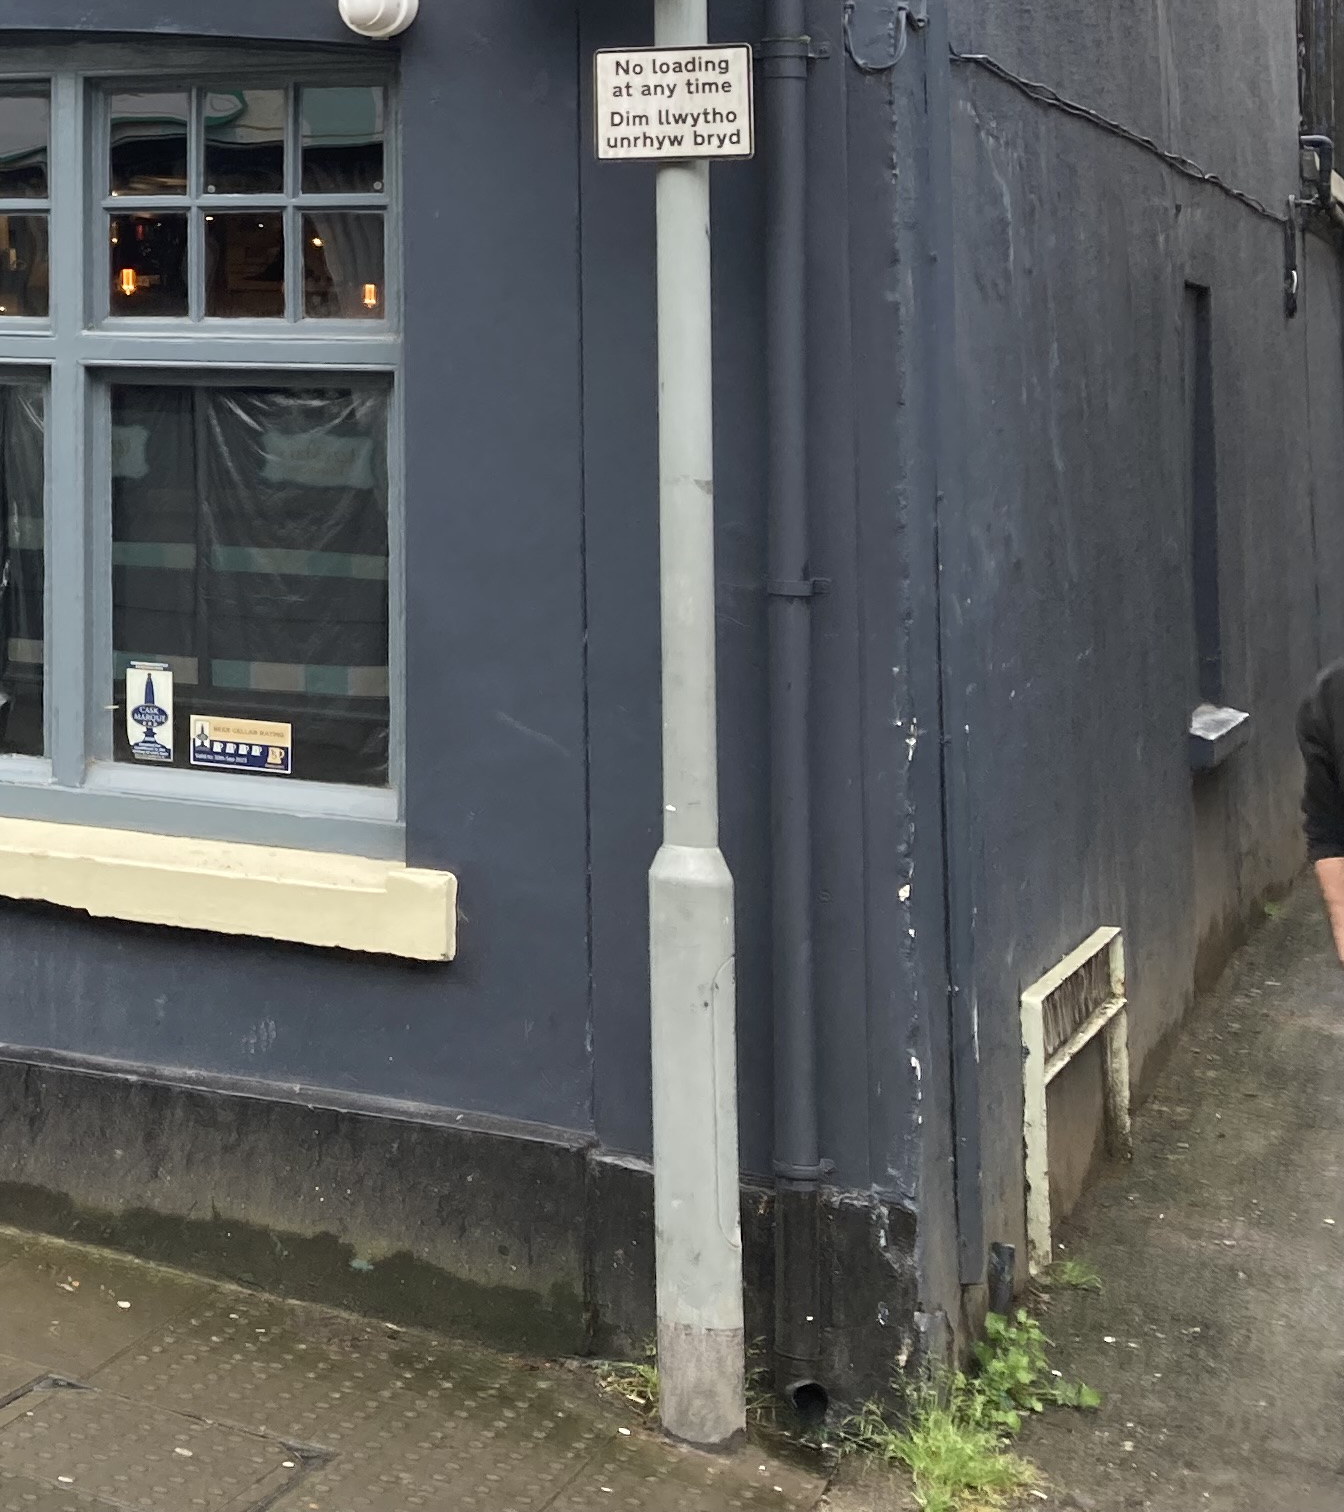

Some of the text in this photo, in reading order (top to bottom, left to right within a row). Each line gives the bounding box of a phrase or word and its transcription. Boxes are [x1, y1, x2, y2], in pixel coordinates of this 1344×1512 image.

[615, 56, 729, 75] No loading
[612, 78, 732, 98] at any time
[610, 108, 737, 127] Dim llwytho
[607, 129, 740, 150] unrhyw bryd
